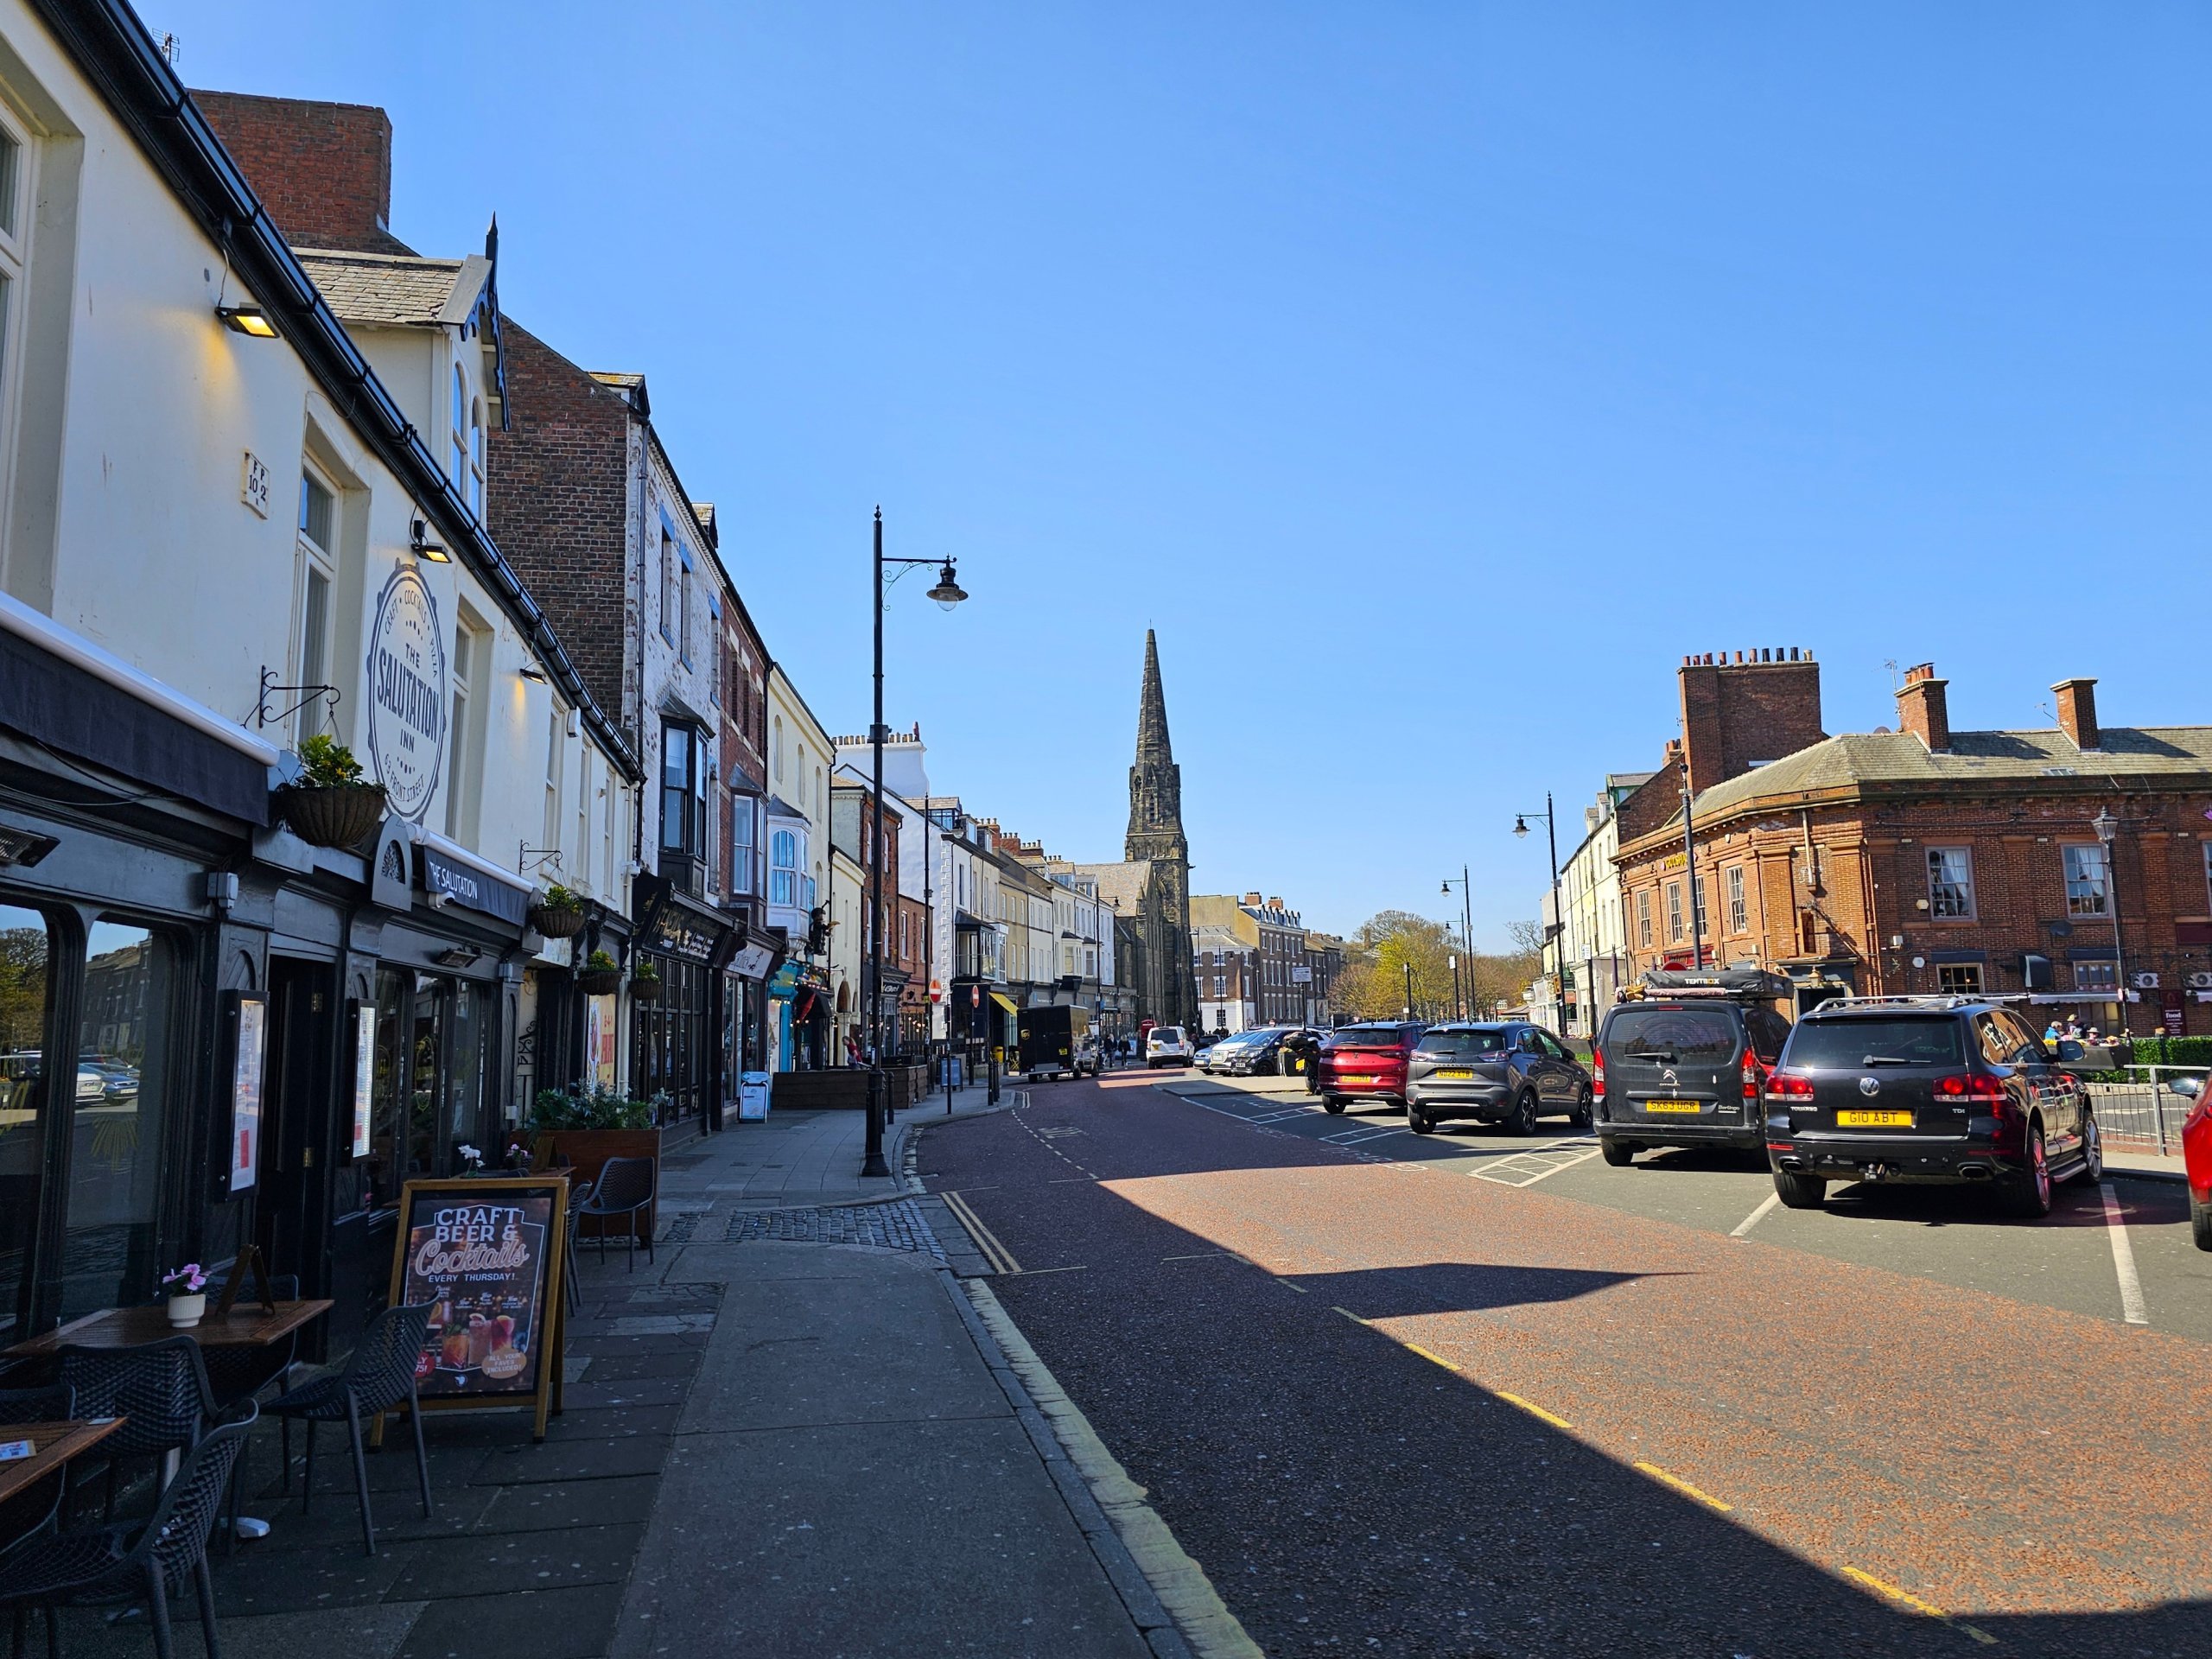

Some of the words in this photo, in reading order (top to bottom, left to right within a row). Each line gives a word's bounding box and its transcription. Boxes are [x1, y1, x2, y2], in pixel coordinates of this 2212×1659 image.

[385, 598, 398, 635] CRAFT
[404, 589, 427, 624] COCKTAILS
[405, 642, 420, 670] THE
[377, 646, 440, 744] SALUTATION
[400, 728, 415, 753] INN
[390, 773, 406, 802] FRONT
[407, 772, 425, 803] STREET
[429, 861, 442, 887] THE
[442, 868, 478, 900] SALUTATION
[1650, 1102, 1675, 1110] SK63
[1677, 1102, 1695, 1110] UGR
[1873, 1112, 1898, 1123] ABT
[436, 1208, 520, 1226] CRAFT
[435, 1225, 495, 1243] BEER
[501, 1224, 518, 1242] &
[415, 1237, 531, 1277] Cocktails
[428, 1274, 459, 1283] EVERY
[464, 1272, 516, 1282] THURSDAY!
[486, 1363, 522, 1373] INCLUDED!
